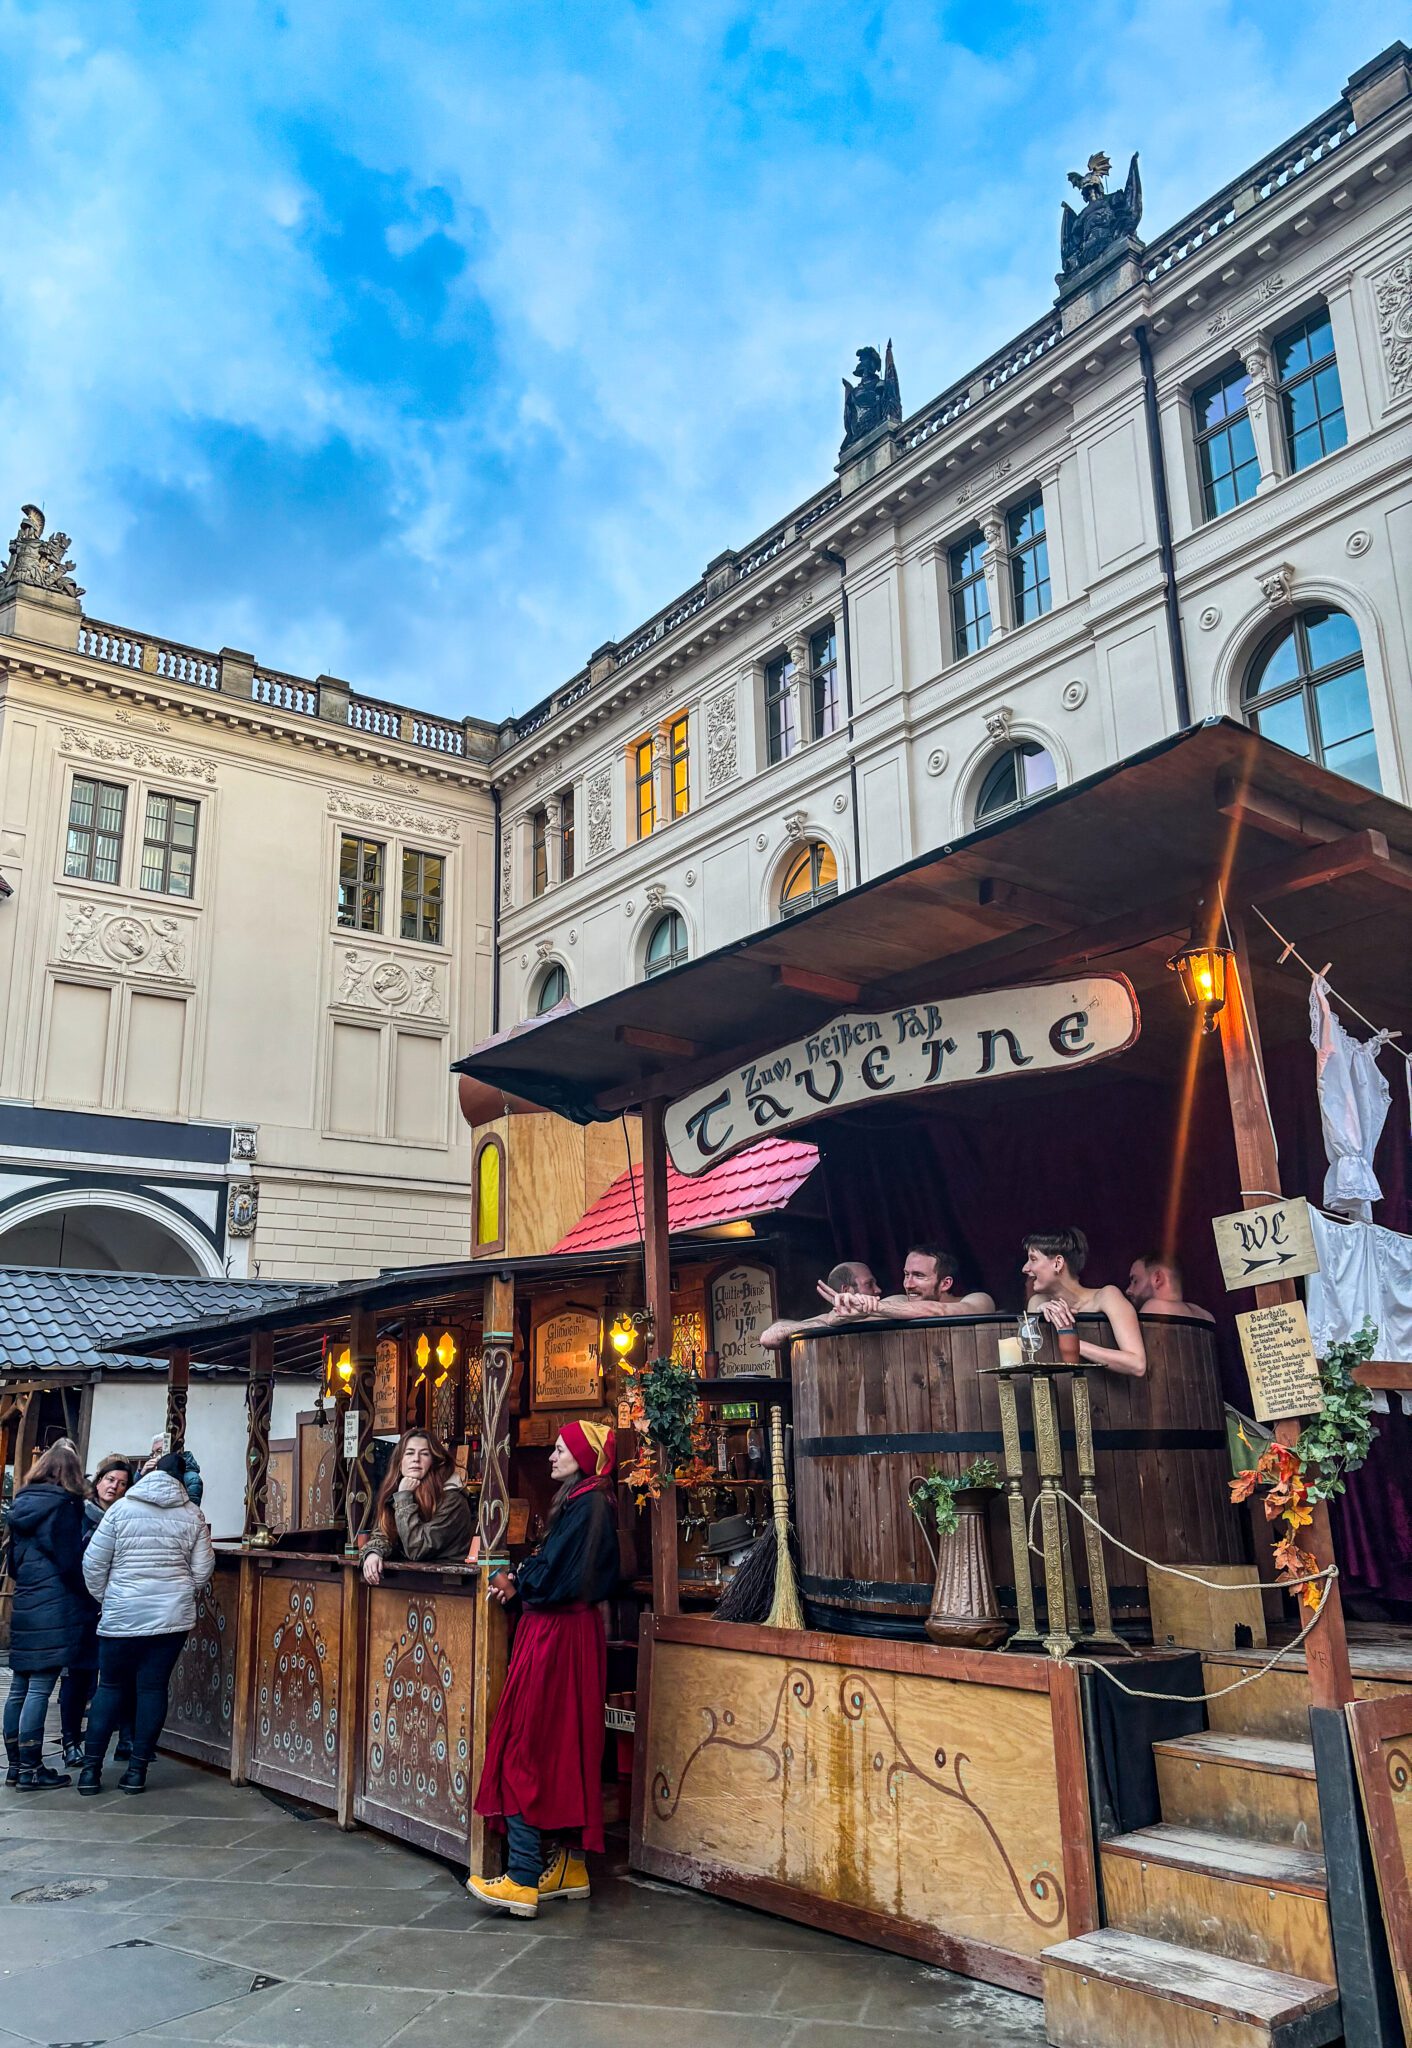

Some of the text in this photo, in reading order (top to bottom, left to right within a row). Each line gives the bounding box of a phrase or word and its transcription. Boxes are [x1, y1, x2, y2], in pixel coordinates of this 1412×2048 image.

[685, 1010, 1095, 1156] Taverne
[741, 1058, 791, 1097] Zum
[892, 1005, 942, 1044] Faß
[1234, 1211, 1289, 1252] WC
[722, 1338, 747, 1358] Met
